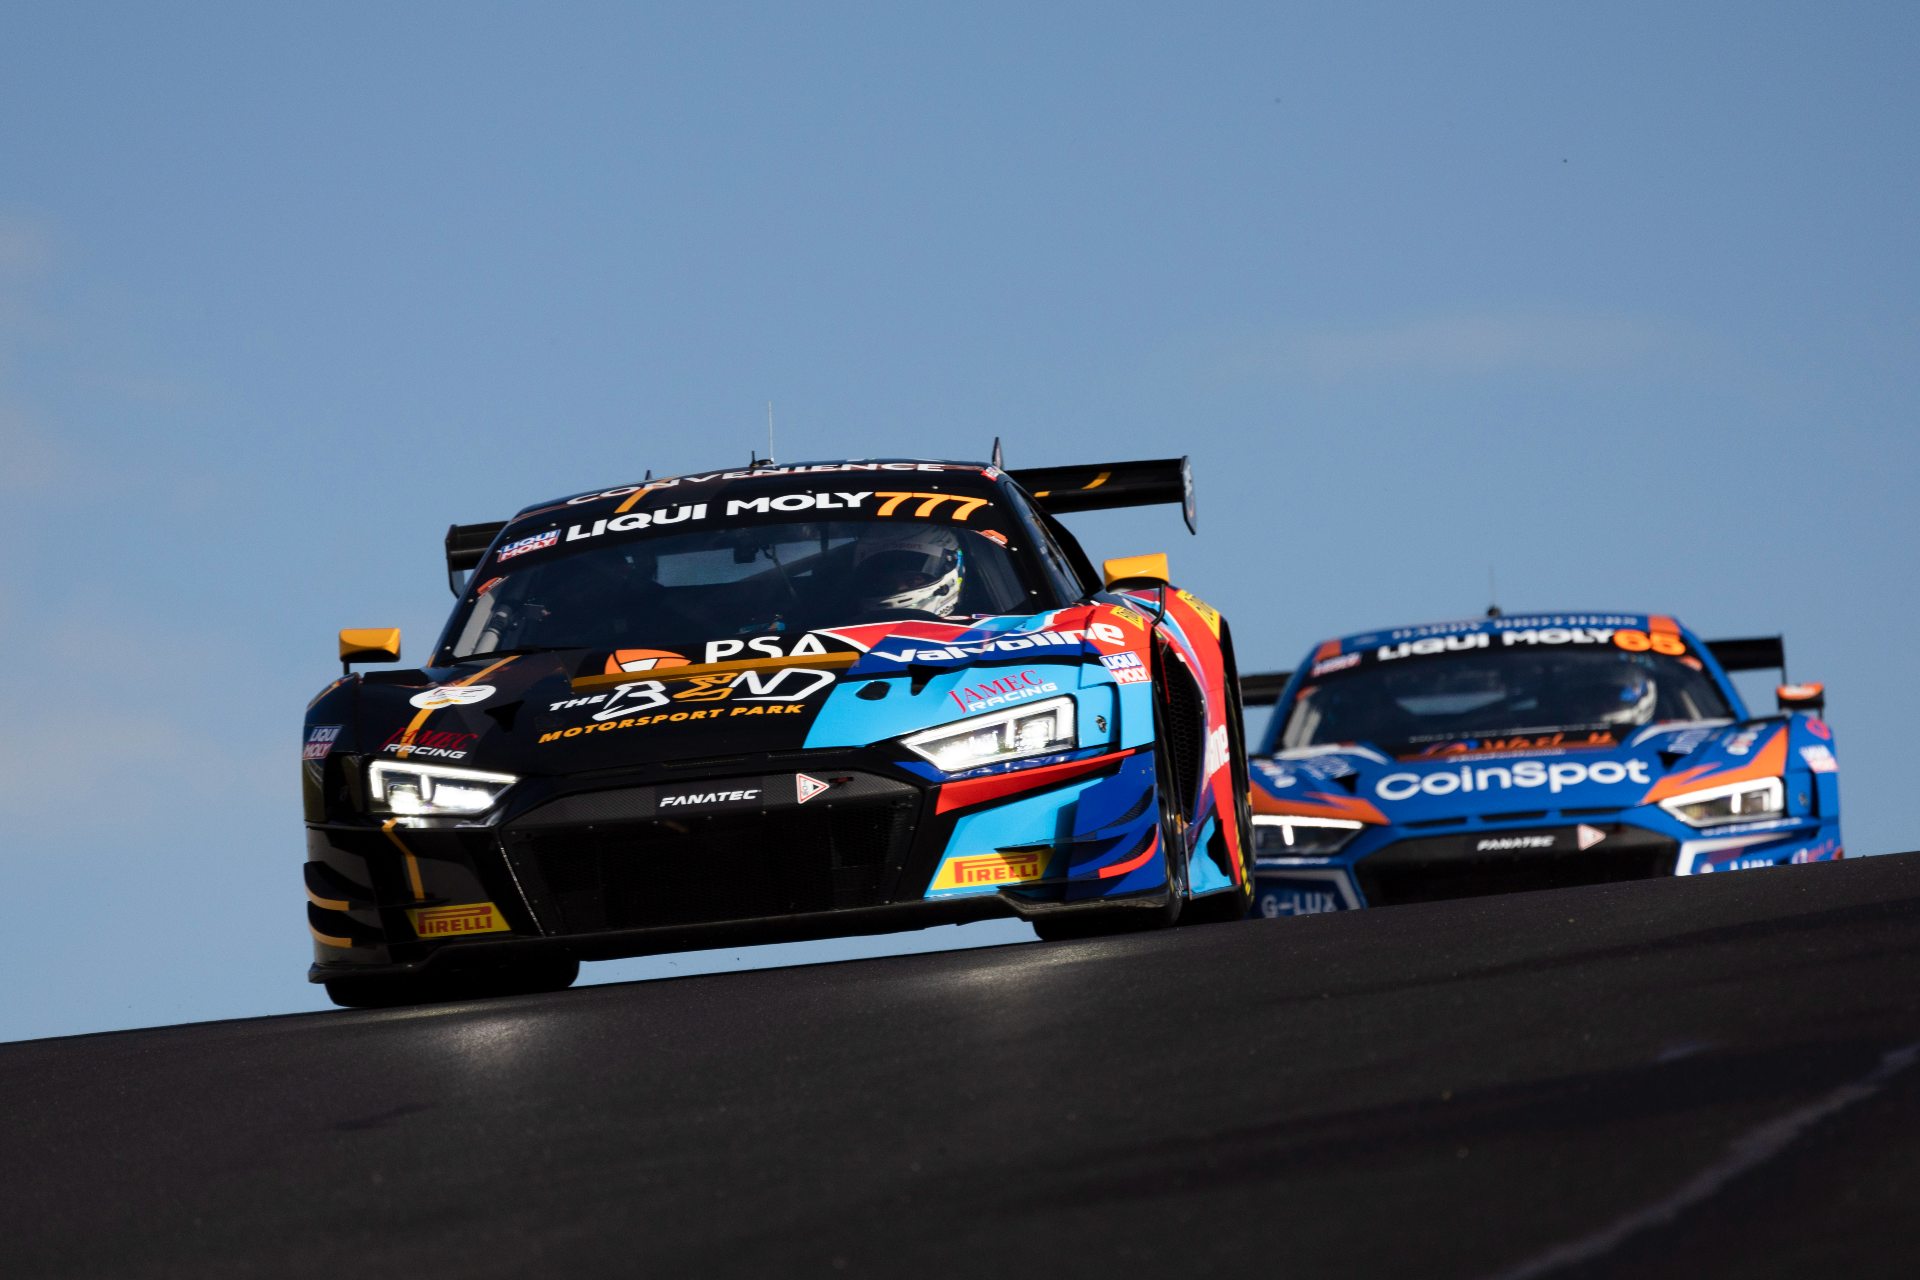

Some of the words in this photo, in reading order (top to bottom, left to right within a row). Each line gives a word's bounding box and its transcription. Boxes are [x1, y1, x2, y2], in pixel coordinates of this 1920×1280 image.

[567, 461, 945, 505] CONVENIENCE
[565, 503, 708, 542] LIQUI
[725, 491, 875, 516] MOLY
[874, 491, 988, 521] 777
[499, 537, 558, 562] MOLY
[501, 529, 558, 552] LIQUI
[705, 633, 828, 665] PSA
[1377, 631, 1490, 662] LIQUI
[1502, 627, 1615, 646] MOLY
[1103, 653, 1143, 671] LIQUI
[1111, 666, 1149, 684] MOLY
[549, 693, 608, 712] THE
[949, 669, 1044, 714] JAMEC
[967, 682, 1059, 712] RACING
[309, 727, 341, 743] LIQUI
[538, 708, 725, 744] MOTORSPORT
[729, 704, 806, 717] PARK
[302, 742, 334, 758] MOLY
[380, 726, 479, 751] JAMEC
[383, 743, 468, 760] RACING
[660, 788, 760, 808] FANATEC
[1476, 835, 1555, 851] FANATEC
[954, 853, 1040, 884] PIRELLI
[416, 905, 493, 935] PIRELLI
